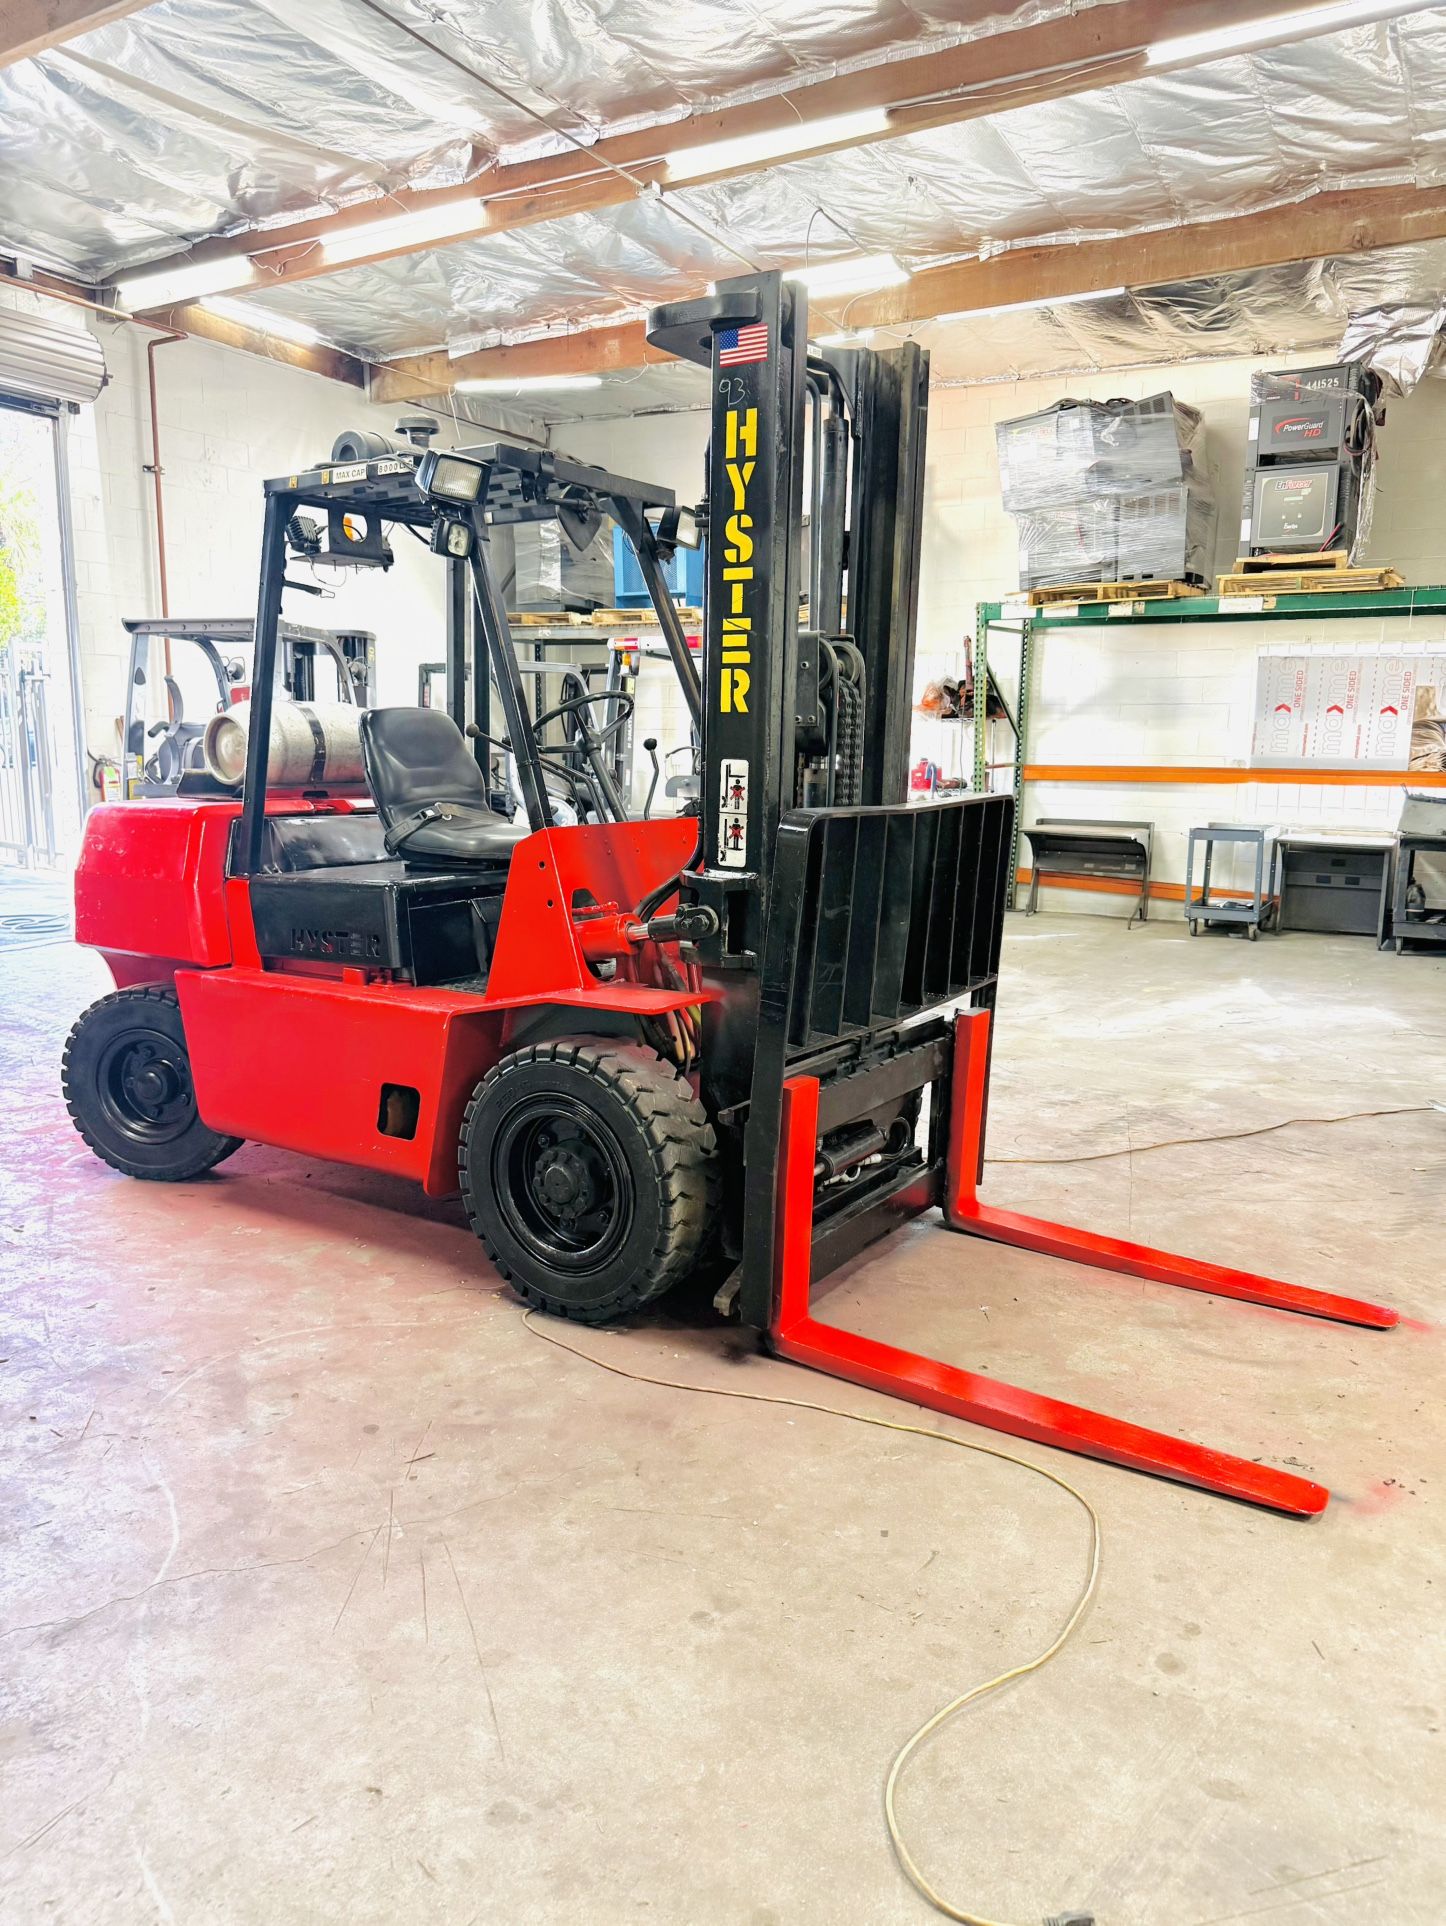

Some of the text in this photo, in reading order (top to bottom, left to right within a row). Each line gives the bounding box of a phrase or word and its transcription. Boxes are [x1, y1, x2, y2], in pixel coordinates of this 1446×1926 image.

[718, 378, 746, 407] 93
[1283, 420, 1324, 432] PowerGuard
[1304, 428, 1321, 437] HD
[336, 468, 365, 479] MAX CAP
[378, 463, 398, 473] 8000
[720, 408, 758, 713] HYSTER
[1294, 670, 1304, 708] ONE SIDED
[1346, 671, 1357, 710] ONE SIDED
[1403, 671, 1412, 692] SIDED
[1401, 694, 1409, 711] ONE
[290, 927, 381, 958] HYSTER
